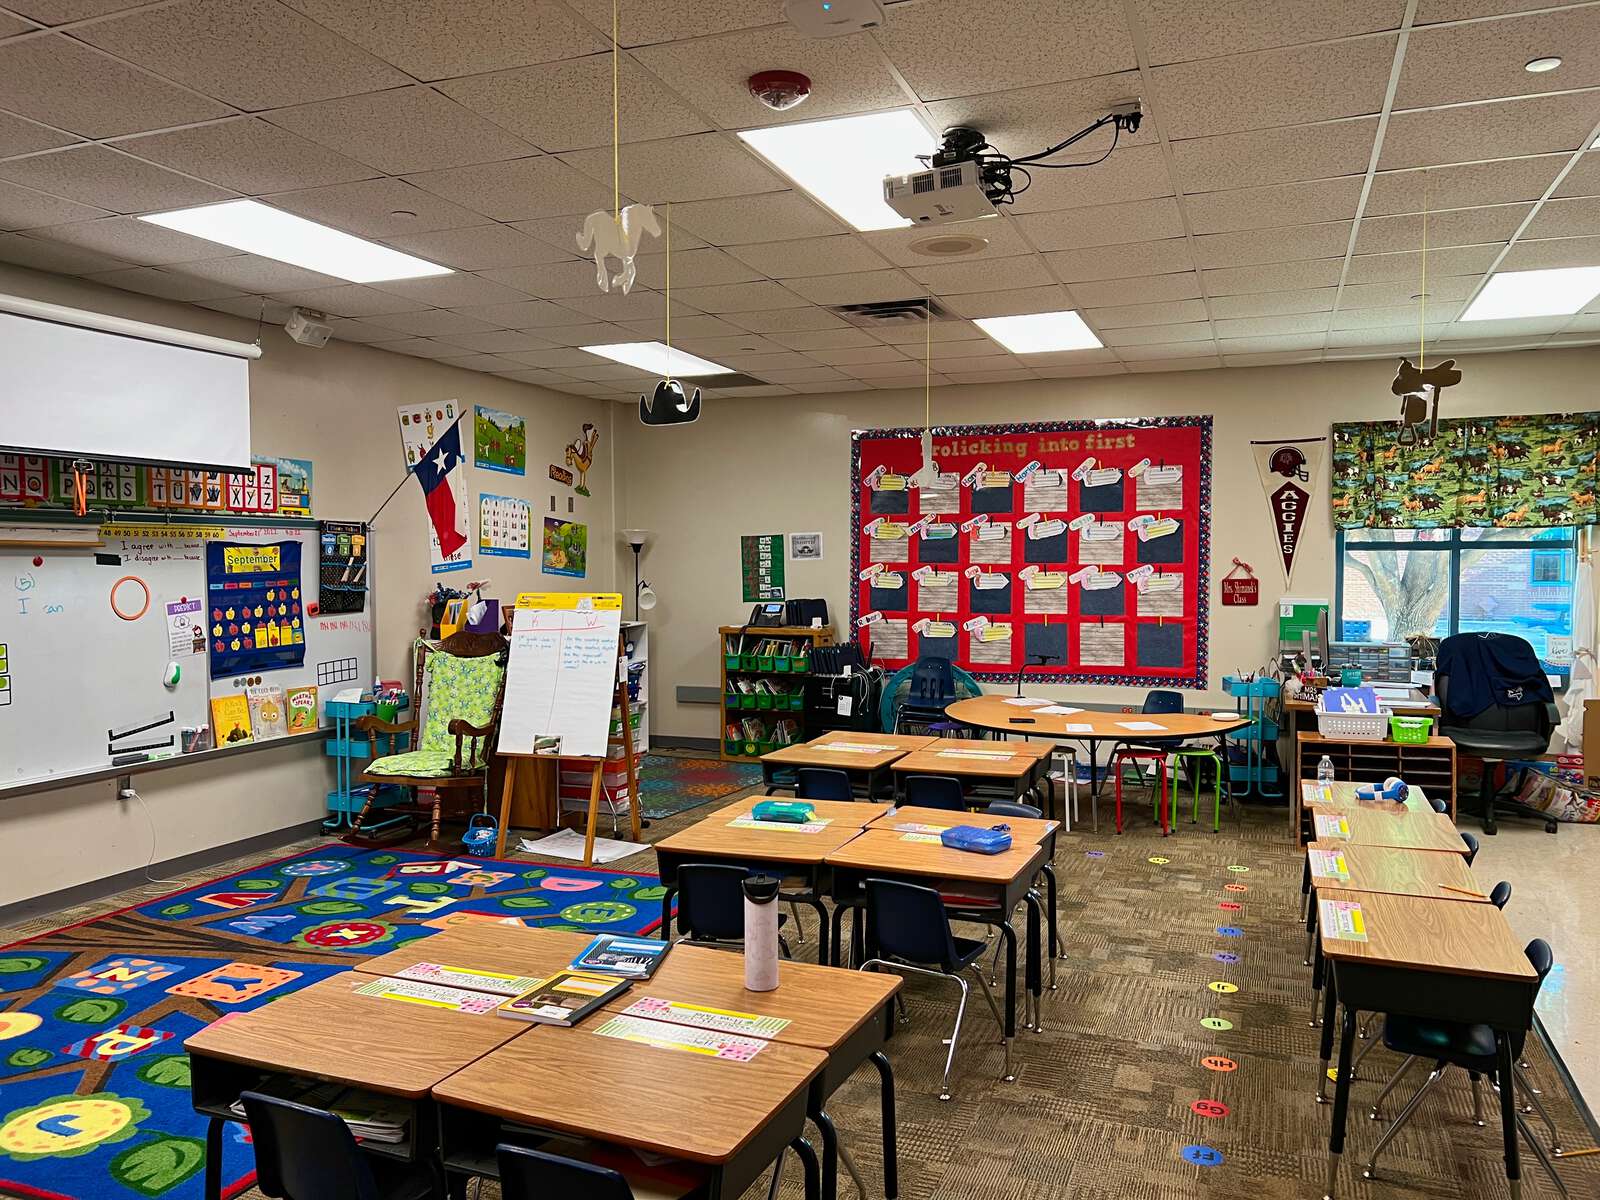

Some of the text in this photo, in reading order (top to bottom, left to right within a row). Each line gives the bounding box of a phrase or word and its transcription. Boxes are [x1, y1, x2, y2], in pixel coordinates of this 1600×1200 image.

[922, 433, 1135, 458] rolicking into first
[4, 474, 18, 491] N
[123, 482, 133, 497] S
[232, 487, 241, 505] X
[264, 492, 272, 506] Z
[1280, 490, 1299, 554] AGGIES
[120, 541, 128, 550] I
[131, 544, 154, 554] agree
[227, 554, 278, 566] September
[1234, 594, 1247, 604] Class
[18, 598, 32, 614] I
[292, 694, 312, 702] MARTHA
[400, 864, 441, 873] B
[540, 876, 603, 892] D
[195, 893, 279, 910] V
[580, 908, 616, 918] E
[326, 928, 370, 940] X
[210, 976, 262, 991] Y
[92, 1028, 160, 1056] P
[1208, 1059, 1232, 1068] Hh
[1197, 1102, 1224, 1115] Gg
[36, 1114, 83, 1137] J
[1192, 1150, 1214, 1161] Ff
